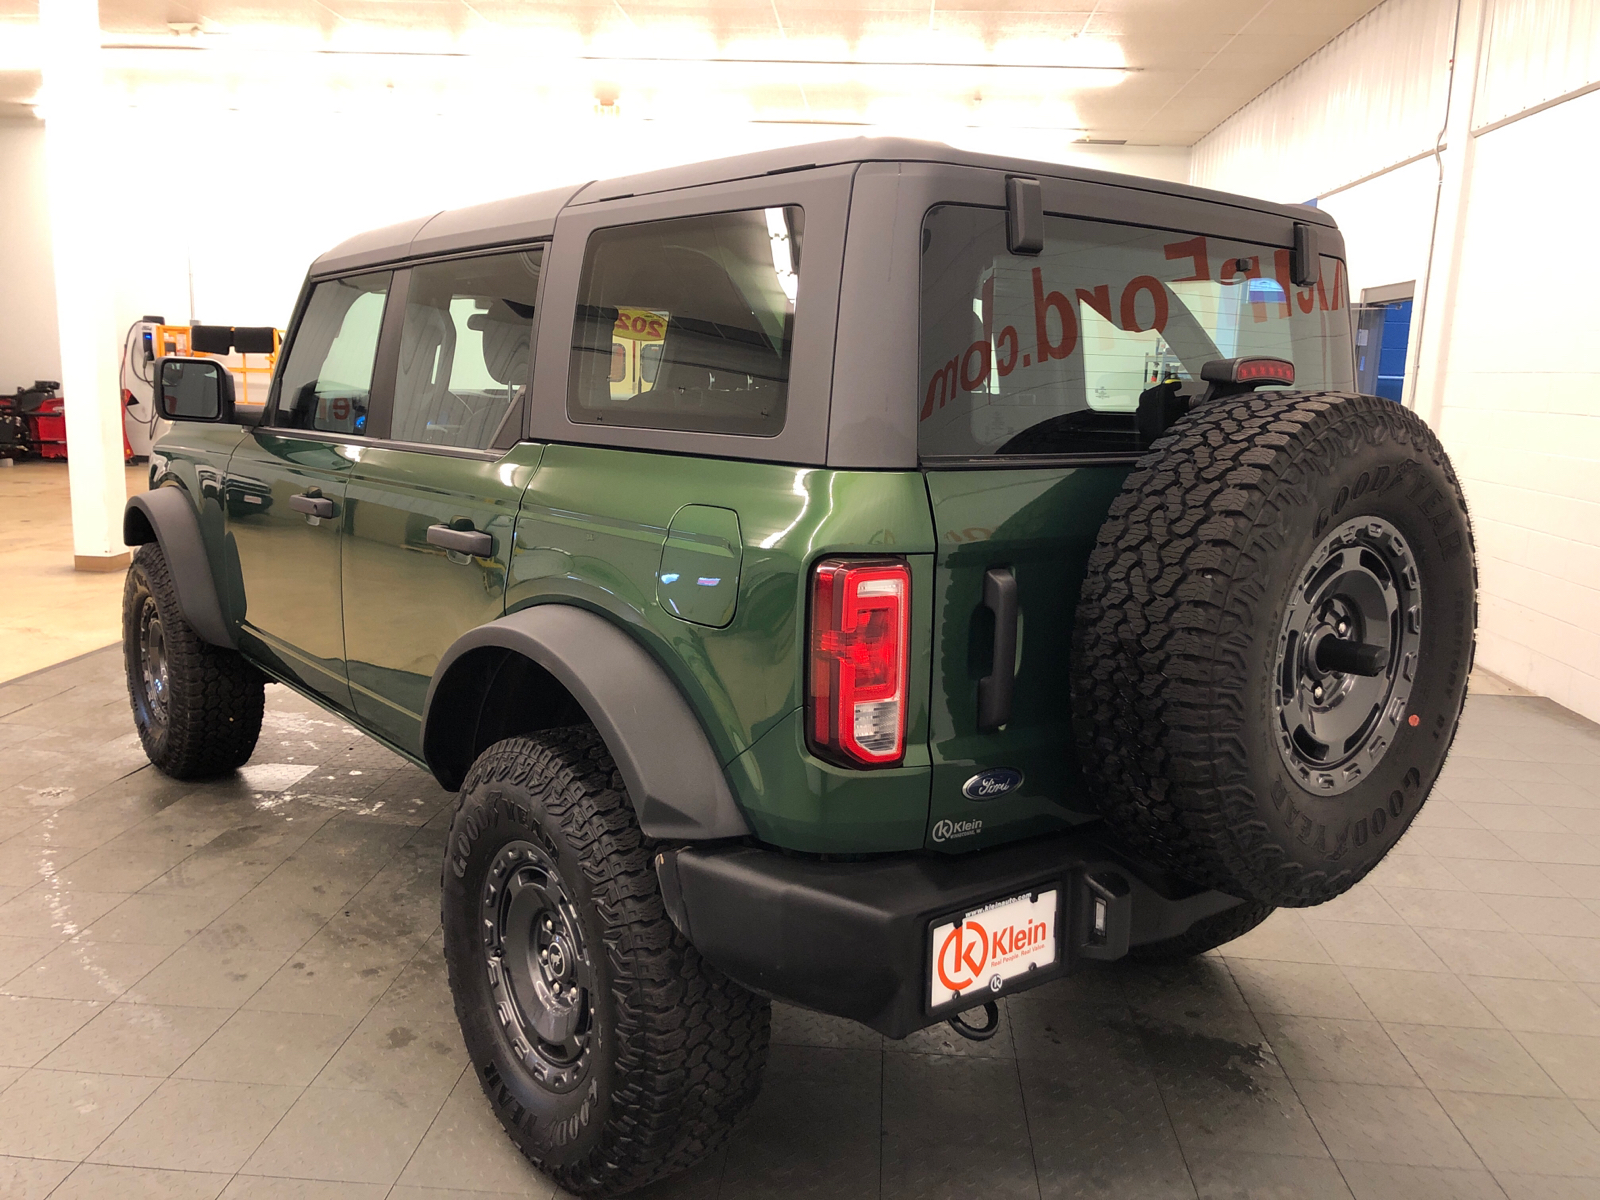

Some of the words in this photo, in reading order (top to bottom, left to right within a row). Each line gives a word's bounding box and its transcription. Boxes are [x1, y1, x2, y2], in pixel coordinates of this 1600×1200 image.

[1312, 458, 1463, 563] GOODYEAR
[978, 778, 1011, 796] Ford
[953, 818, 983, 834] Klein
[1270, 764, 1422, 863] GOODYEAR
[452, 790, 560, 878] GOODYEAR
[964, 891, 1032, 918] www.kleinauto.com
[991, 918, 1047, 959] Klein
[990, 958, 1002, 968] Real
[1020, 948, 1031, 956] Real
